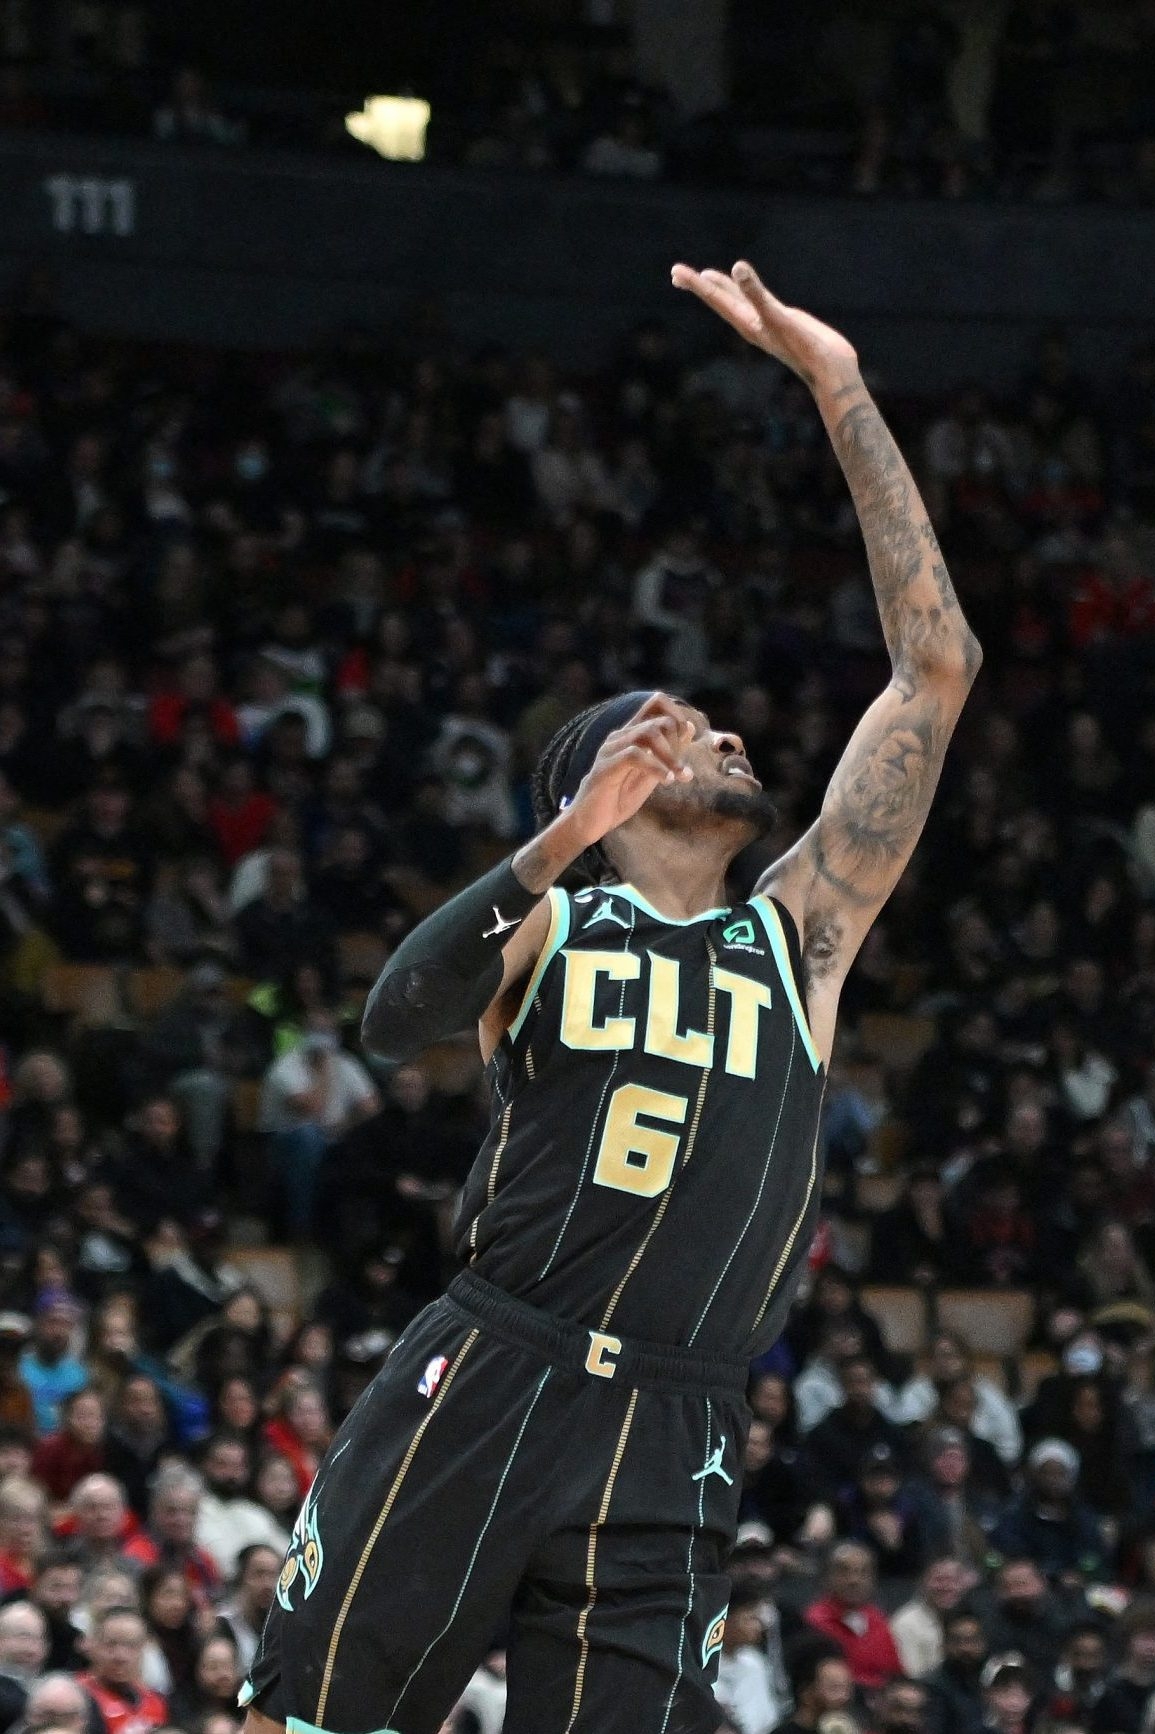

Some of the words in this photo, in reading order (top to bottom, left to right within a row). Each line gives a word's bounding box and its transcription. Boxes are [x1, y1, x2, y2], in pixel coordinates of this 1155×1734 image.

[558, 949, 772, 1081] CLT
[593, 1082, 689, 1198] 6
[585, 1330, 622, 1379] C
